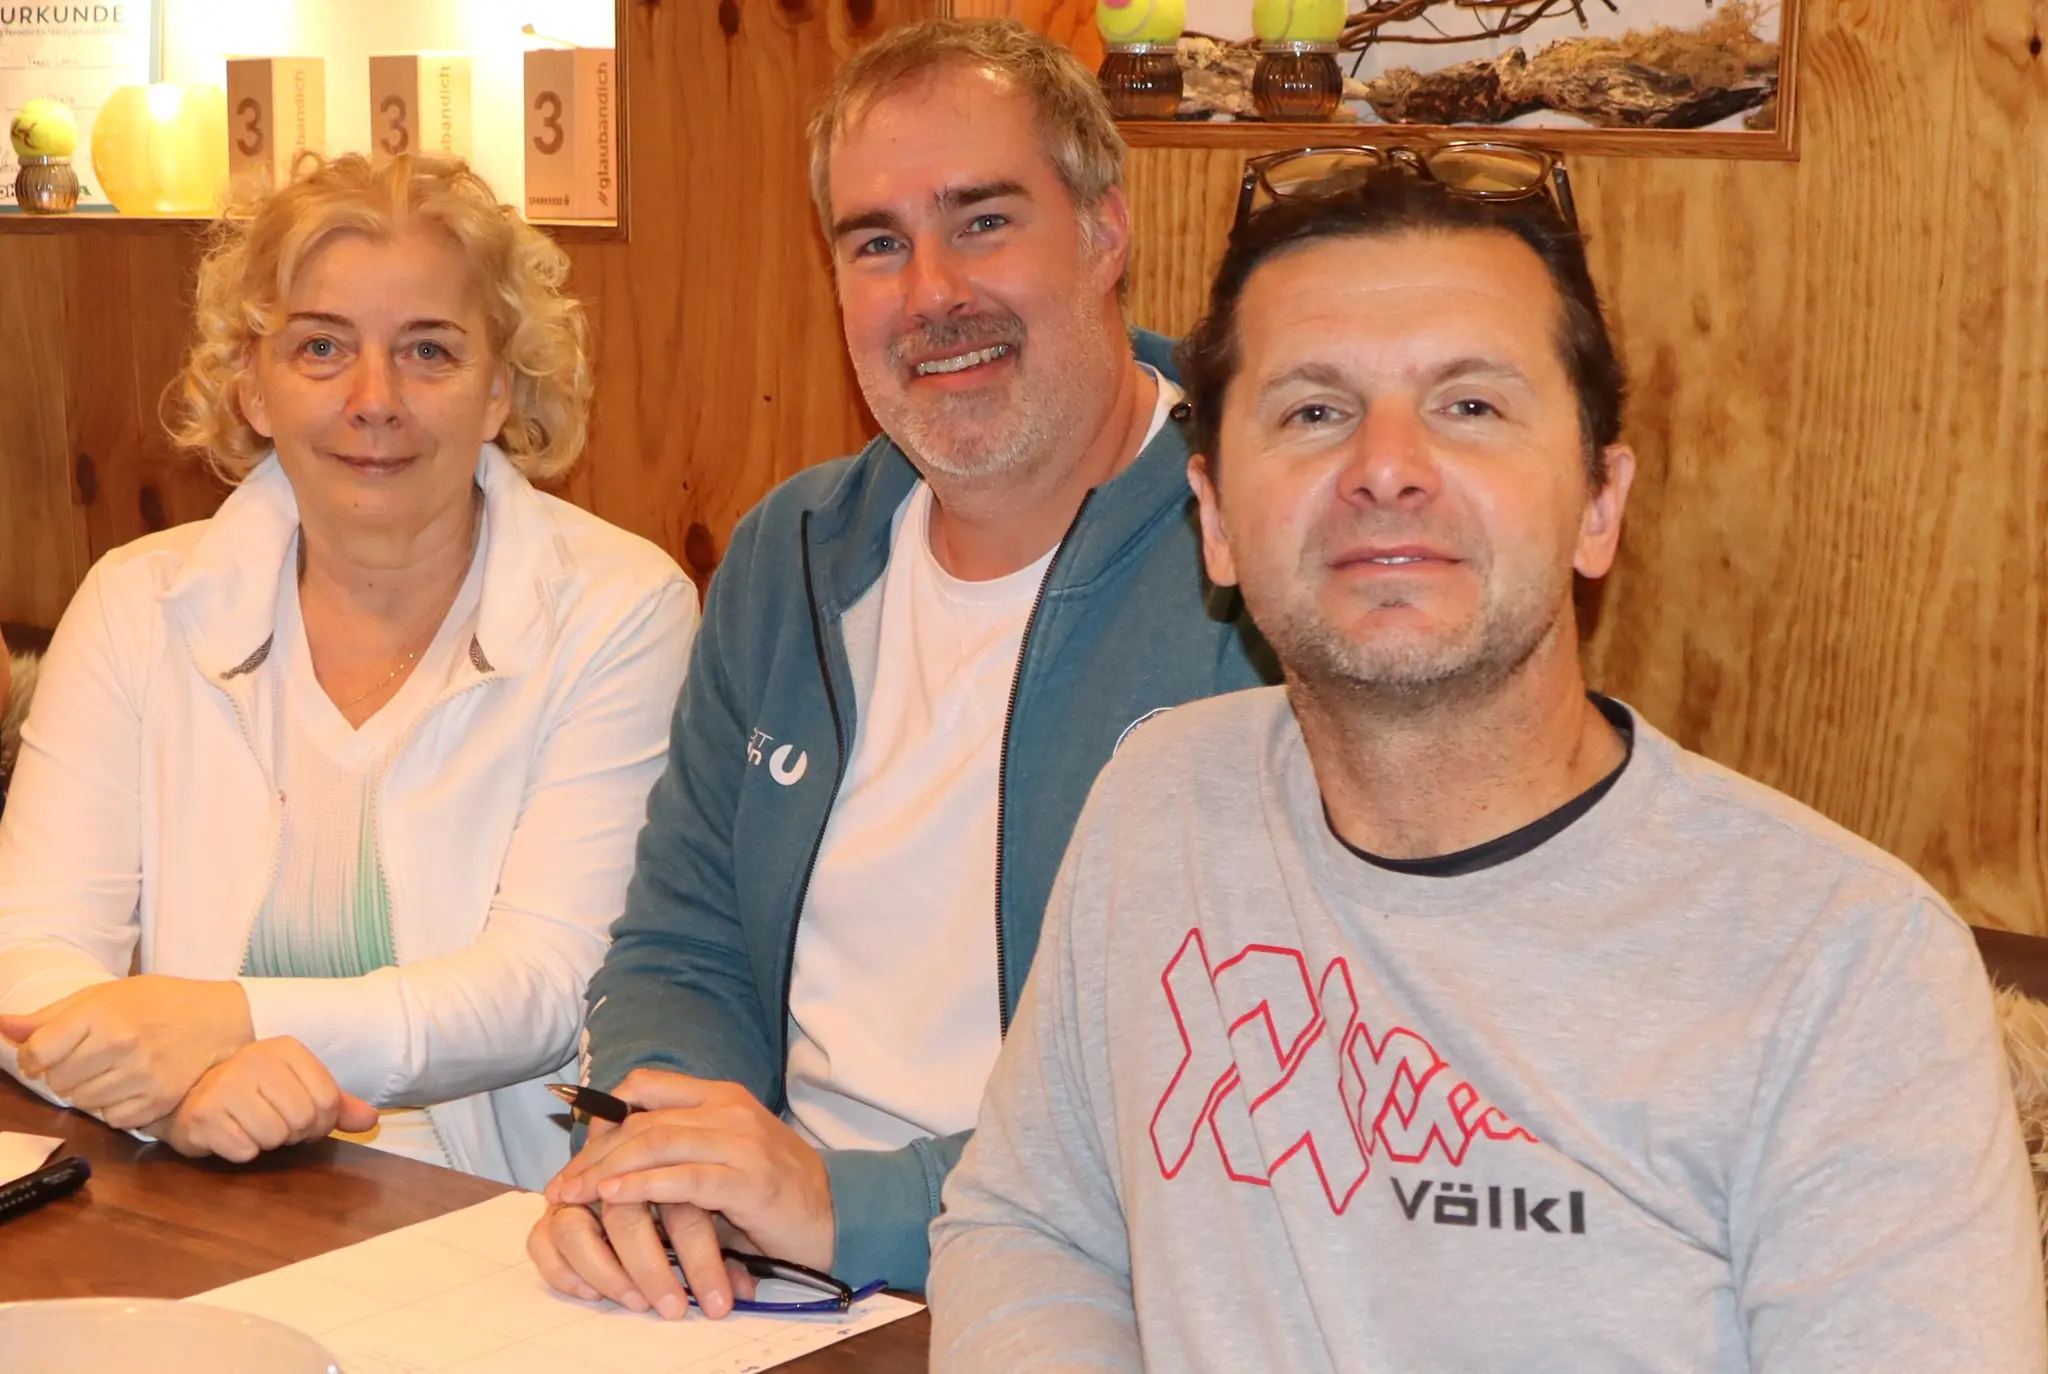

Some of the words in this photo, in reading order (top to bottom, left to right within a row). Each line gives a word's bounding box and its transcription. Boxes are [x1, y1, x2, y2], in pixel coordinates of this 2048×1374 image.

[1, 5, 126, 25] URKUNDE
[236, 97, 264, 156] 3
[293, 70, 305, 152] bandich
[380, 94, 409, 155] 3
[533, 90, 564, 155] 3
[596, 62, 611, 207] #glaubandich
[1390, 1176, 1586, 1234] Völkl
